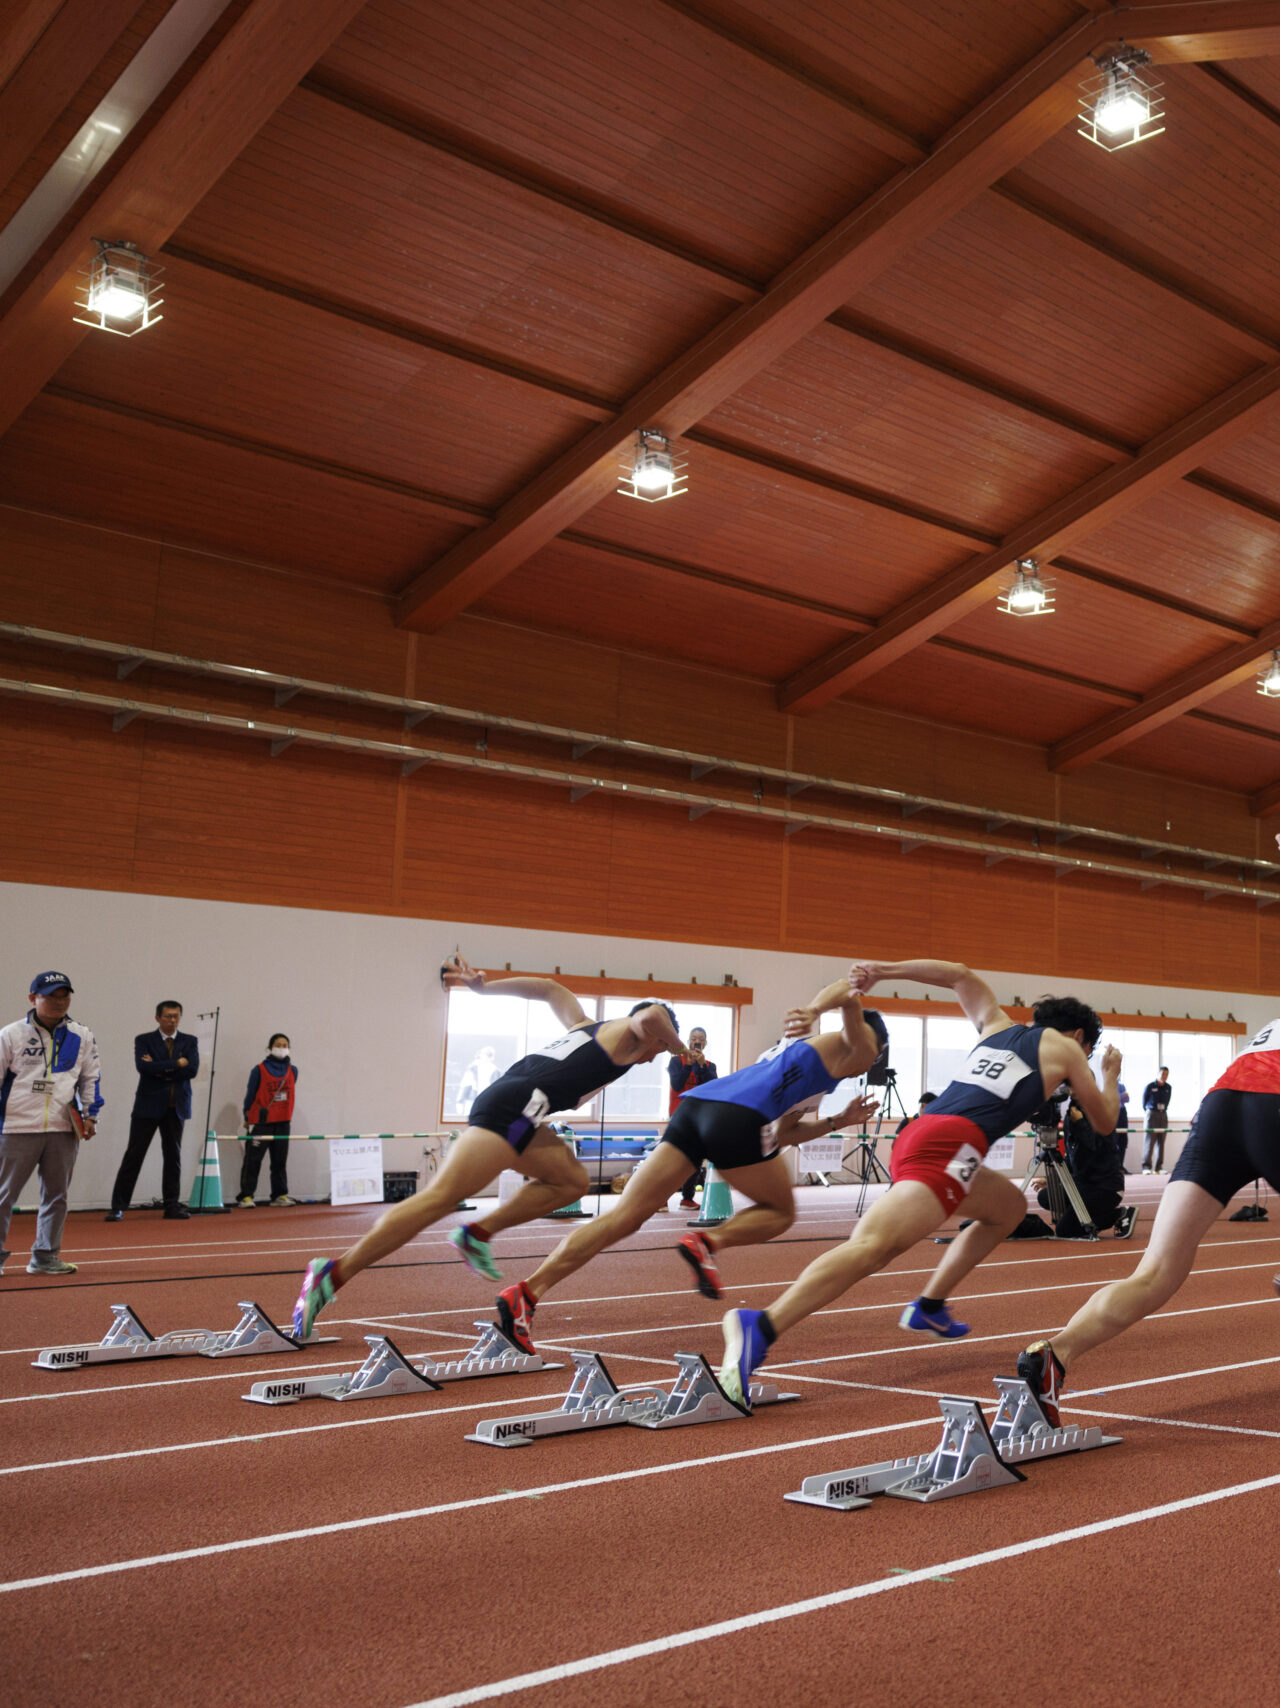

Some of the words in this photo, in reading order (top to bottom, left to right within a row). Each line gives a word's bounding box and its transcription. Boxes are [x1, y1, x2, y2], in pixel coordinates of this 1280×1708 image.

[971, 1058, 1006, 1080] 38
[960, 1157, 978, 1183] 3
[51, 1350, 89, 1364] NISHI
[266, 1382, 306, 1398] NISHI
